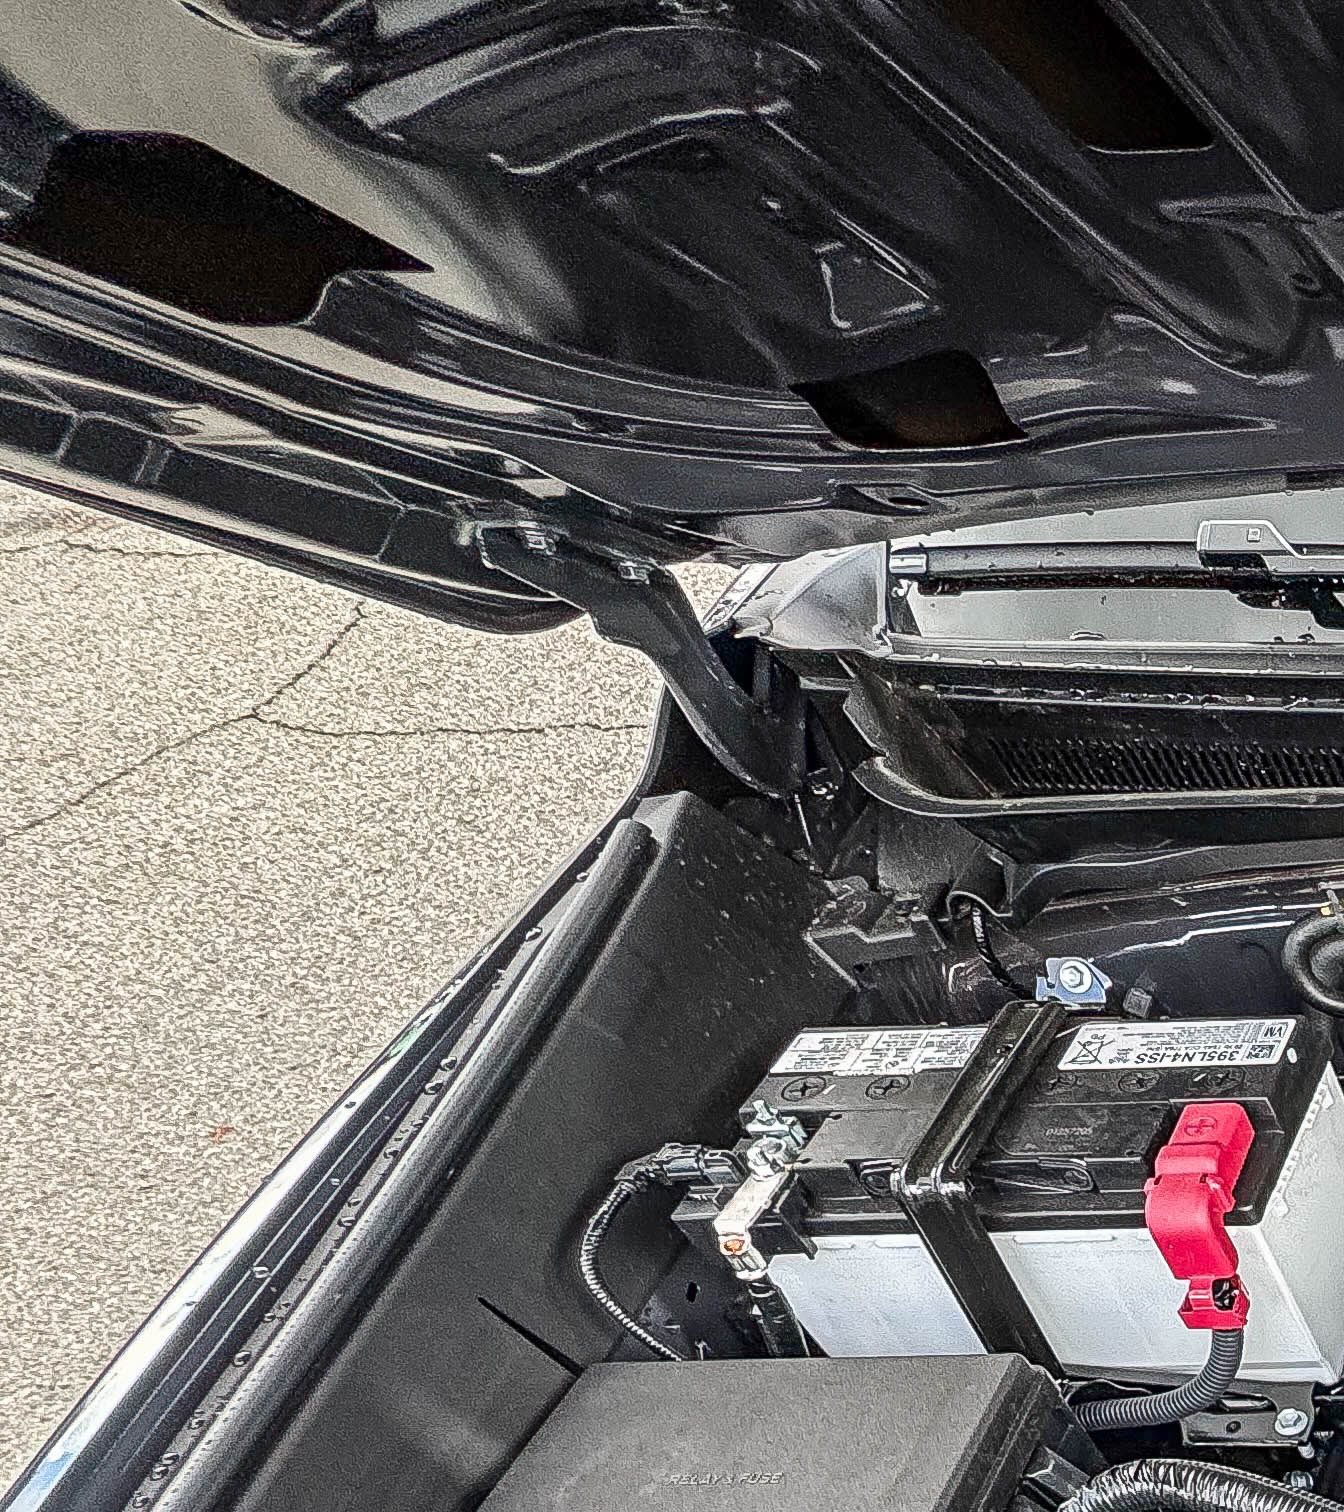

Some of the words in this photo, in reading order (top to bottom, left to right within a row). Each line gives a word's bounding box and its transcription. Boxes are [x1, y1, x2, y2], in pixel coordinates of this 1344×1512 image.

[1264, 1026, 1285, 1038] VM
[1134, 1050, 1240, 1065] 395LN4-ISS
[665, 1473, 722, 1486] RELAY
[739, 1471, 785, 1485] FUSE
